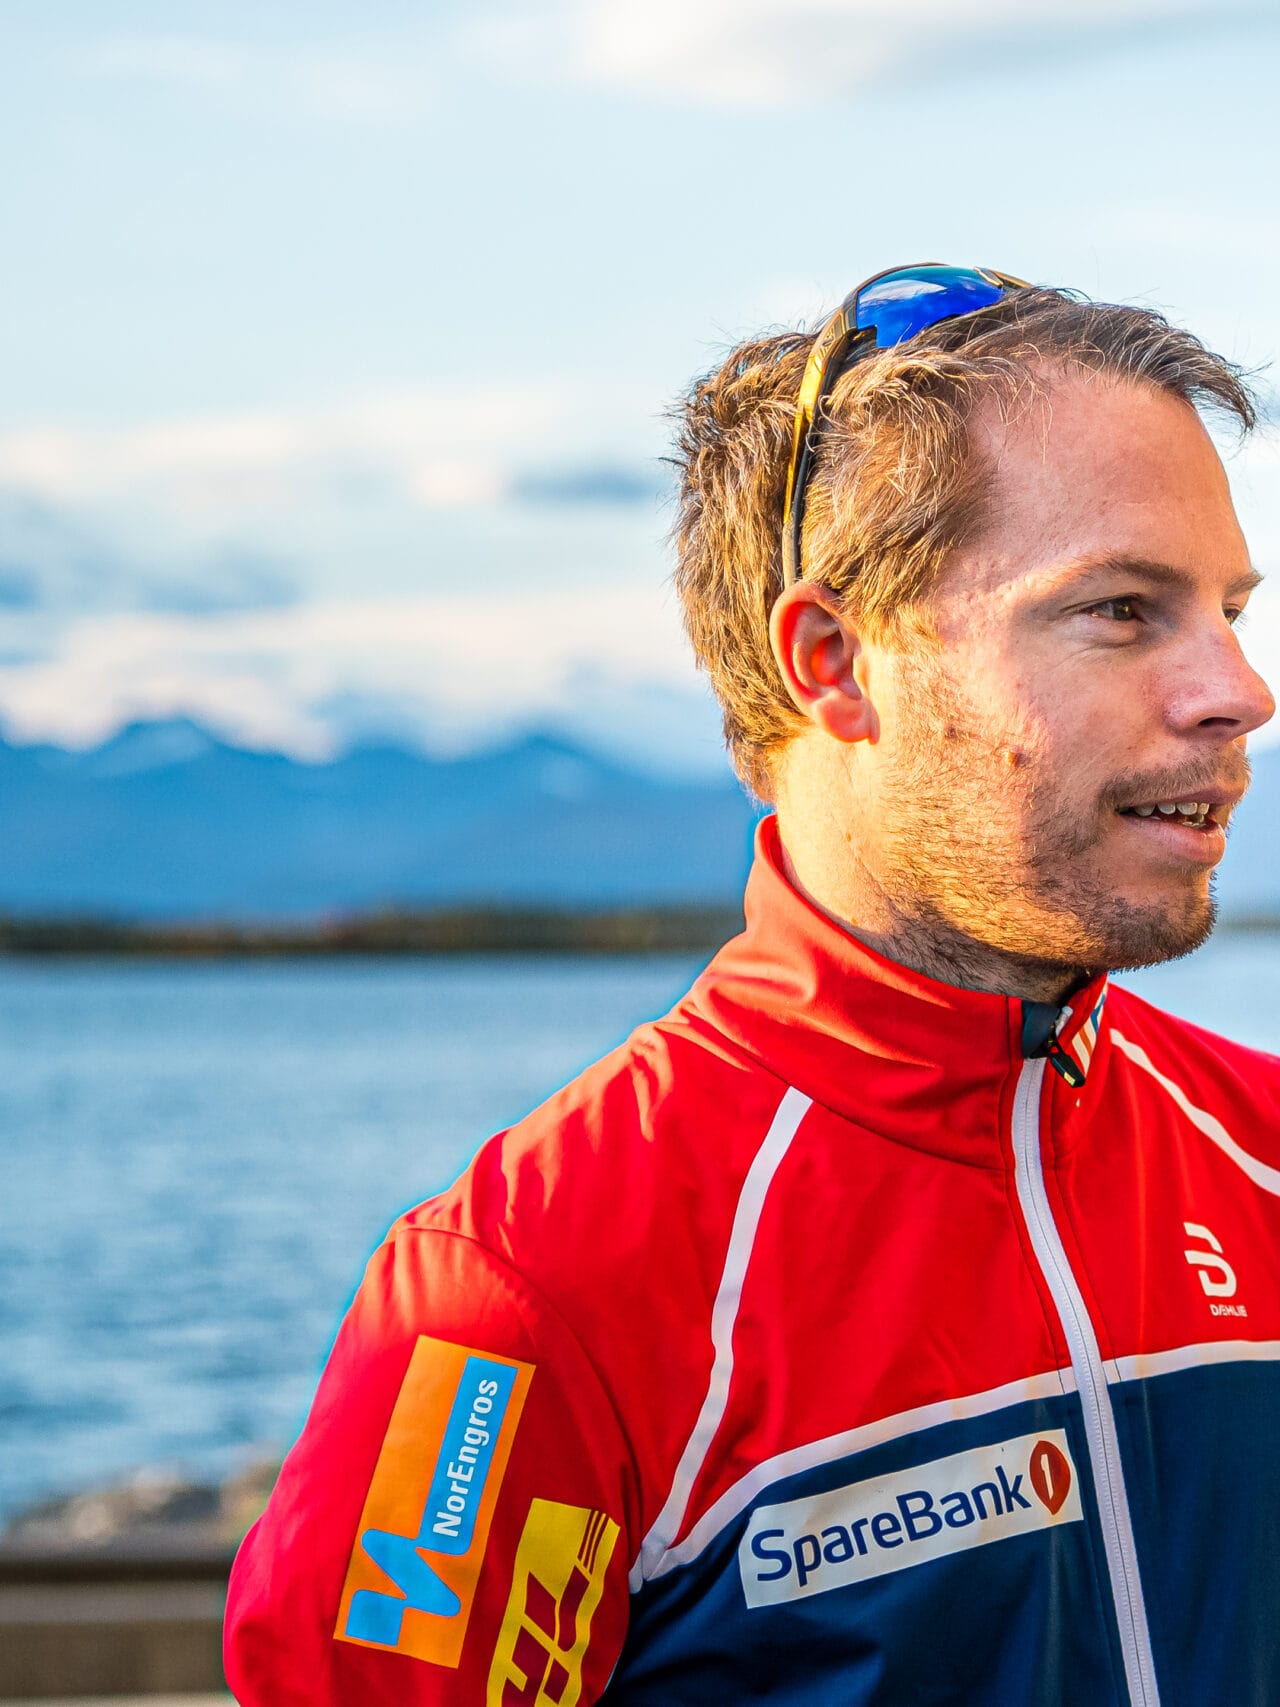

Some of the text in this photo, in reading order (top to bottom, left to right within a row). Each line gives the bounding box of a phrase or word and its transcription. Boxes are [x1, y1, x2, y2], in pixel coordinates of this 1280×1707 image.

[432, 1379, 498, 1537] NorEngros
[751, 1465, 1032, 1587] SpareBank
[500, 1565, 590, 1707] HL
